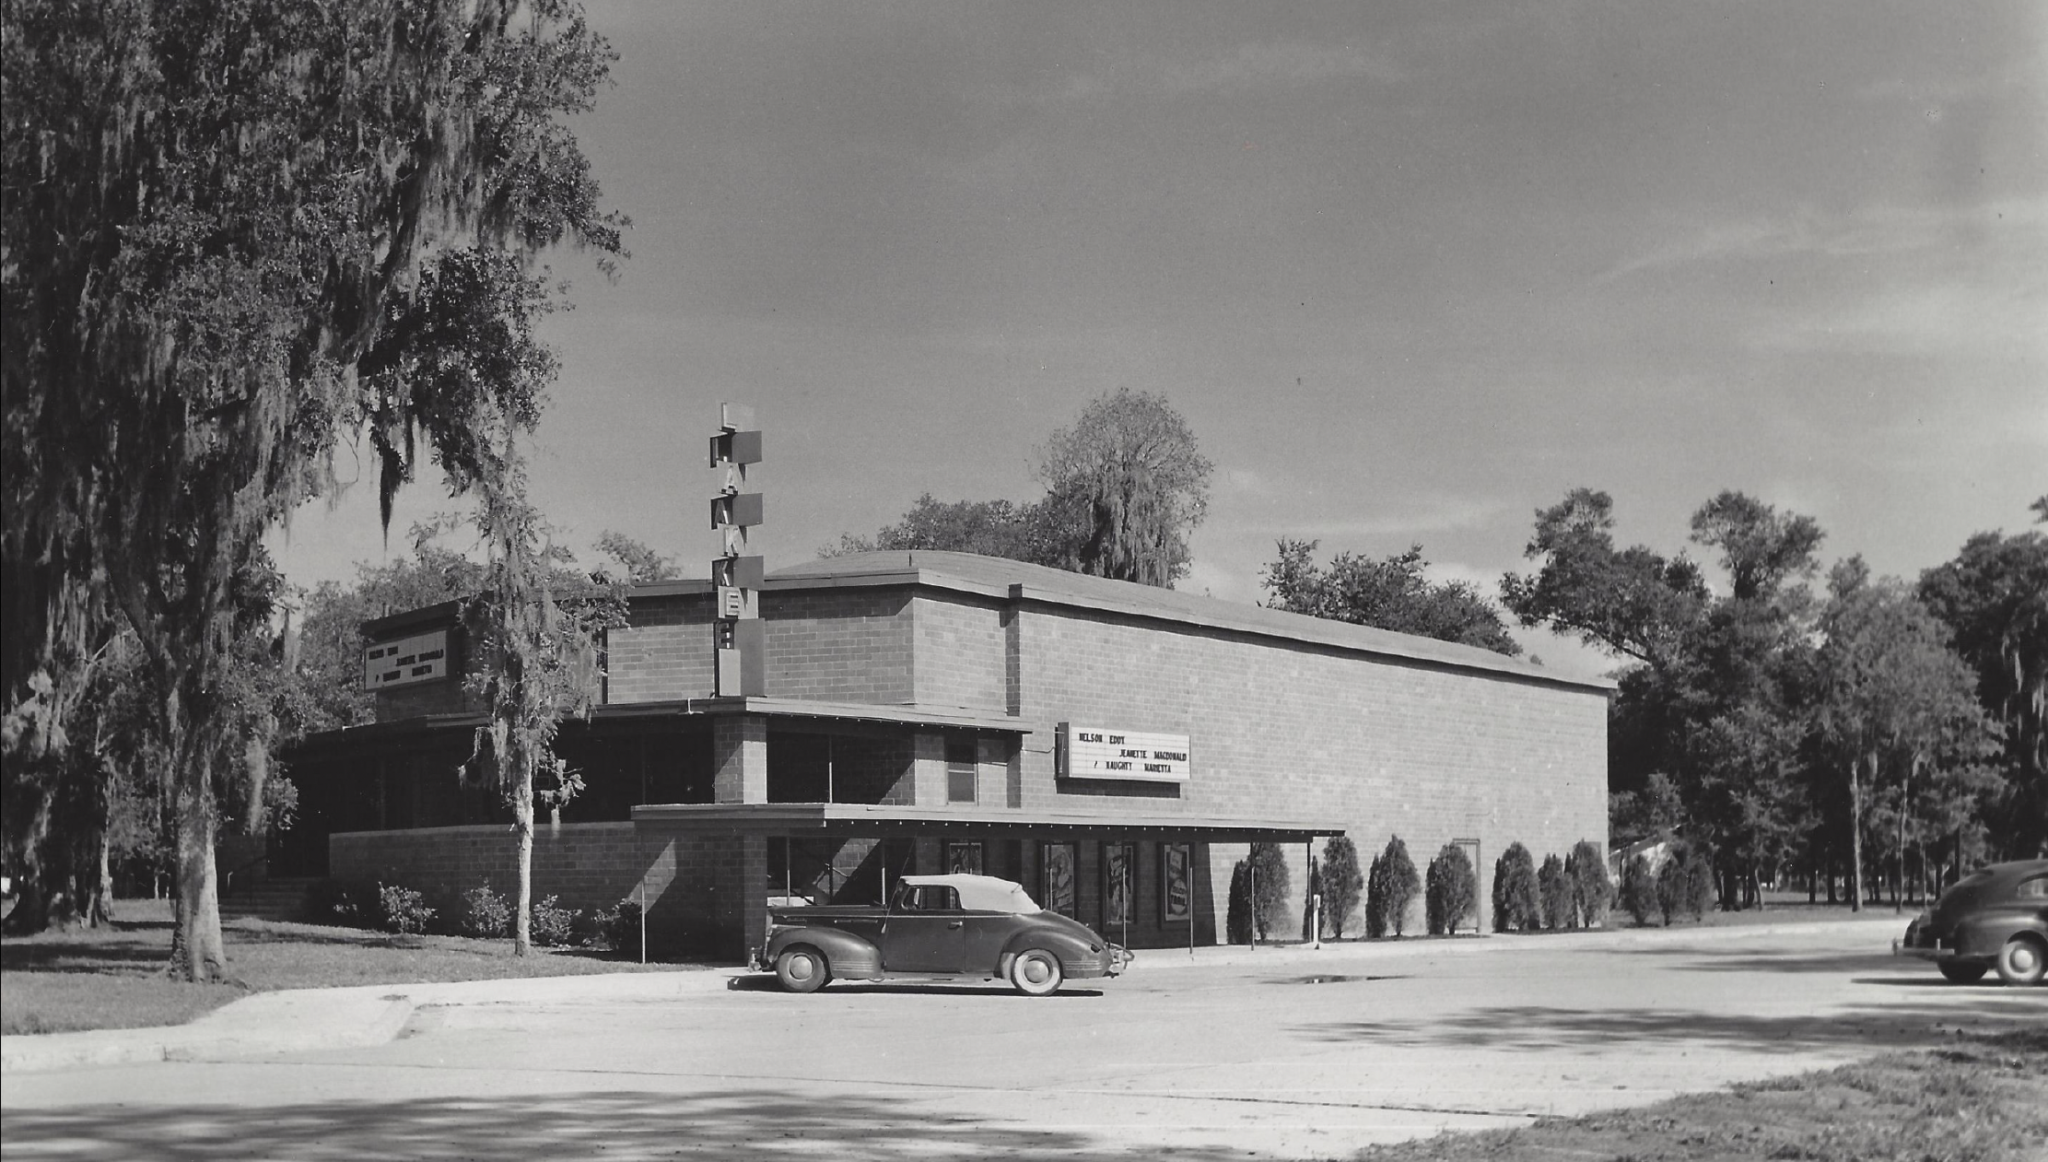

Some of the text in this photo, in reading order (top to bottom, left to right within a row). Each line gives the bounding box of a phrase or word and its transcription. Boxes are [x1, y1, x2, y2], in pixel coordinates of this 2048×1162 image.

[1079, 733, 1125, 745] NELSON EDDY
[1154, 751, 1187, 762] MACDONALD
[1106, 761, 1132, 771] NAUGHTY
